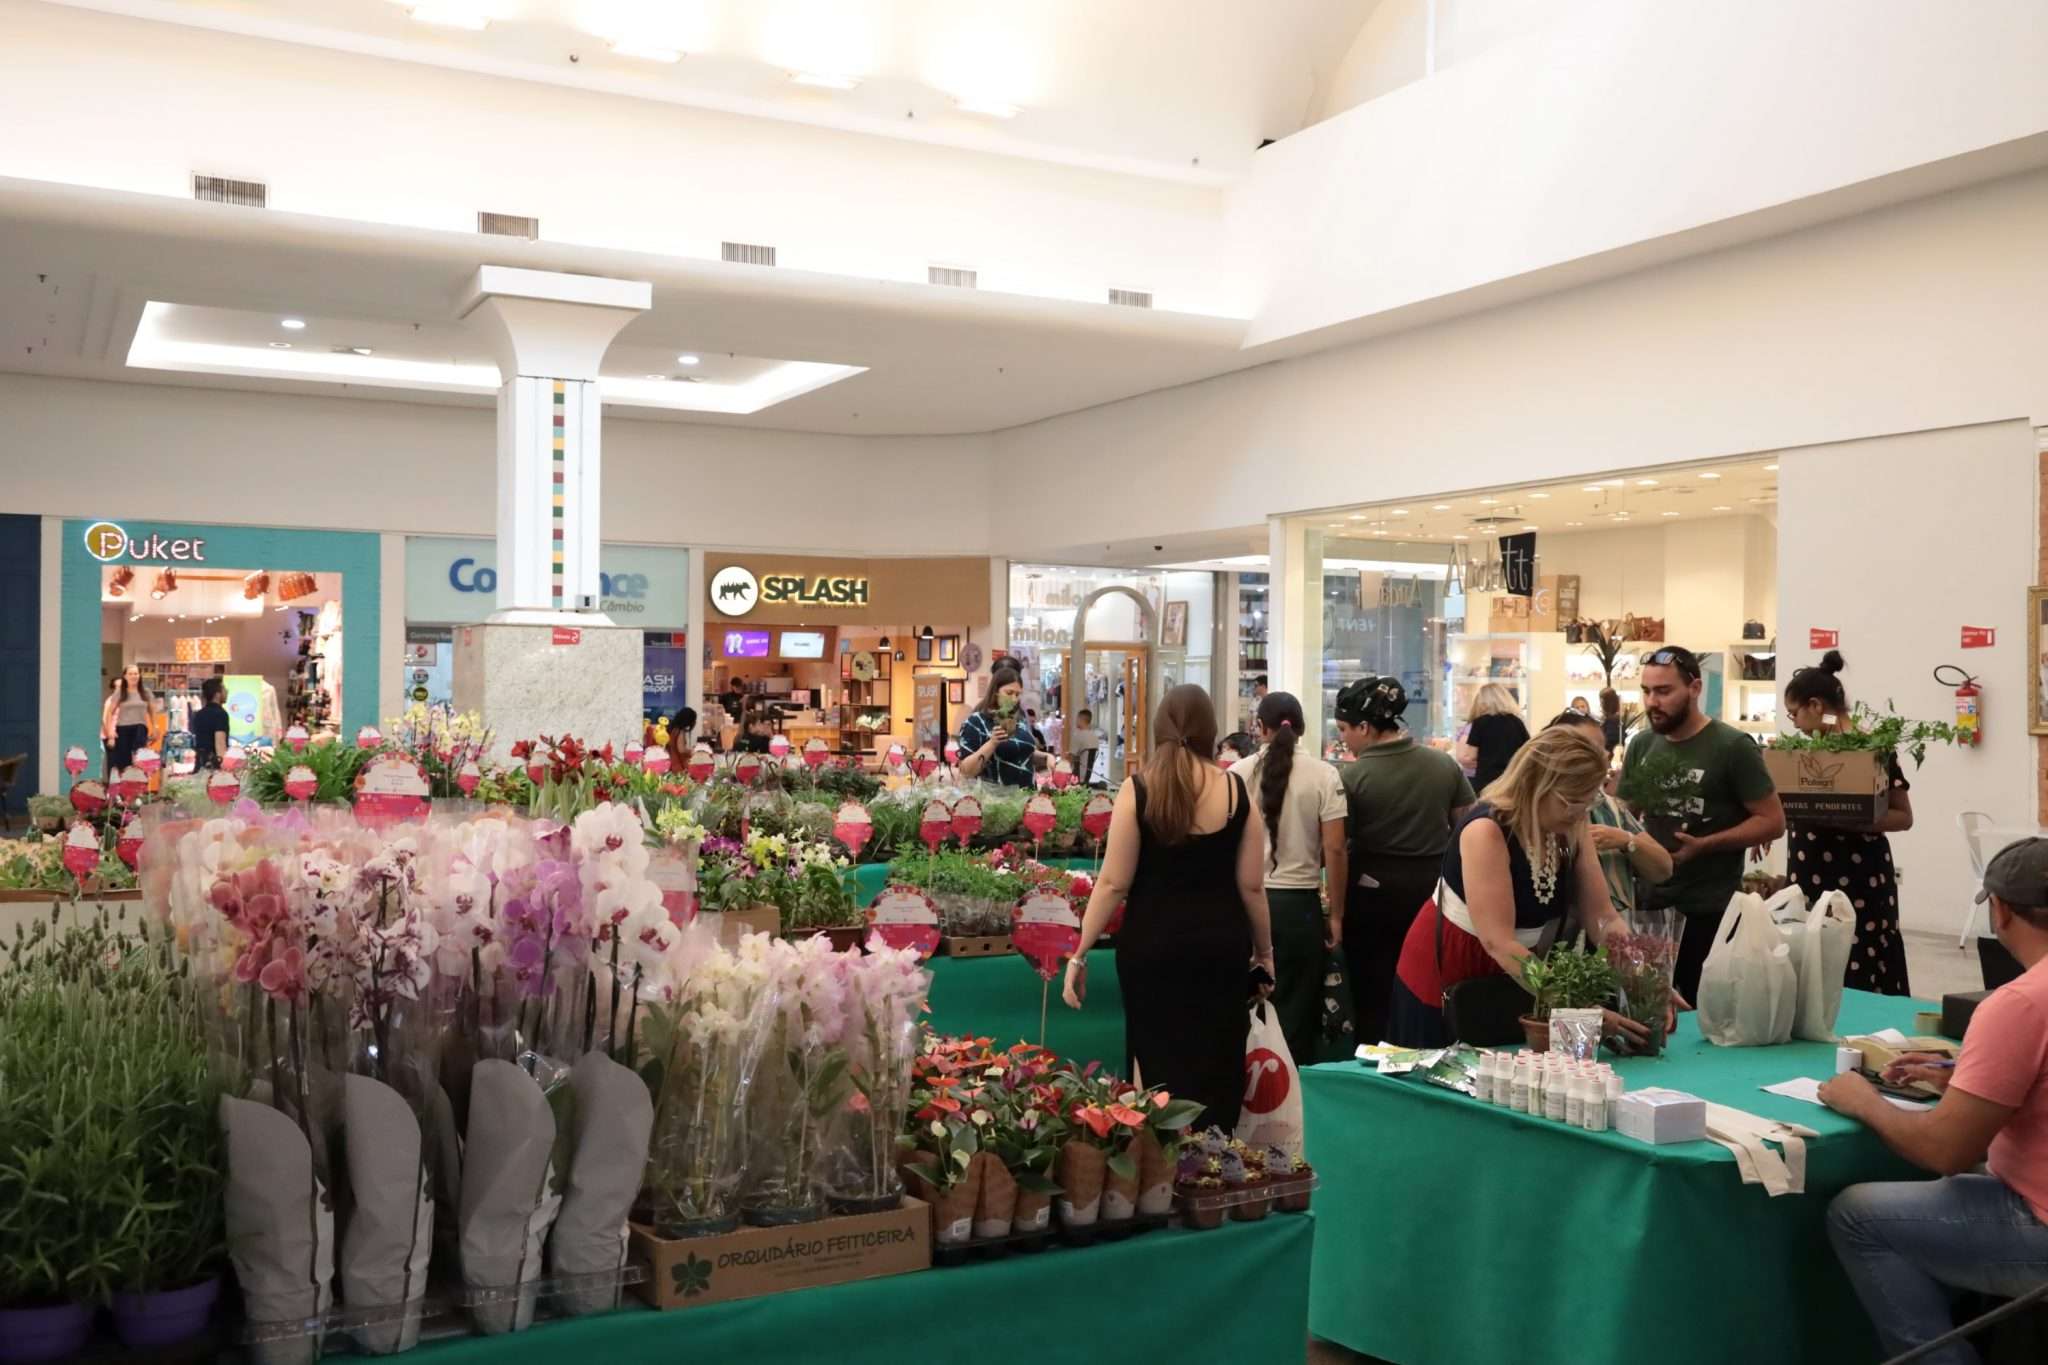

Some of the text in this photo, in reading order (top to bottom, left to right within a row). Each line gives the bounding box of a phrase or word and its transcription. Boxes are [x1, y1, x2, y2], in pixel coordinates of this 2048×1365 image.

[98, 530, 205, 560] Puket
[763, 576, 868, 603] SPLASH
[600, 601, 645, 613] Câmbio
[644, 674, 674, 685] ASH
[1815, 802, 1862, 811] PENDENTES
[718, 1237, 824, 1269] ORQUIDÁRIO
[827, 1226, 915, 1254] FEITICEIRA
